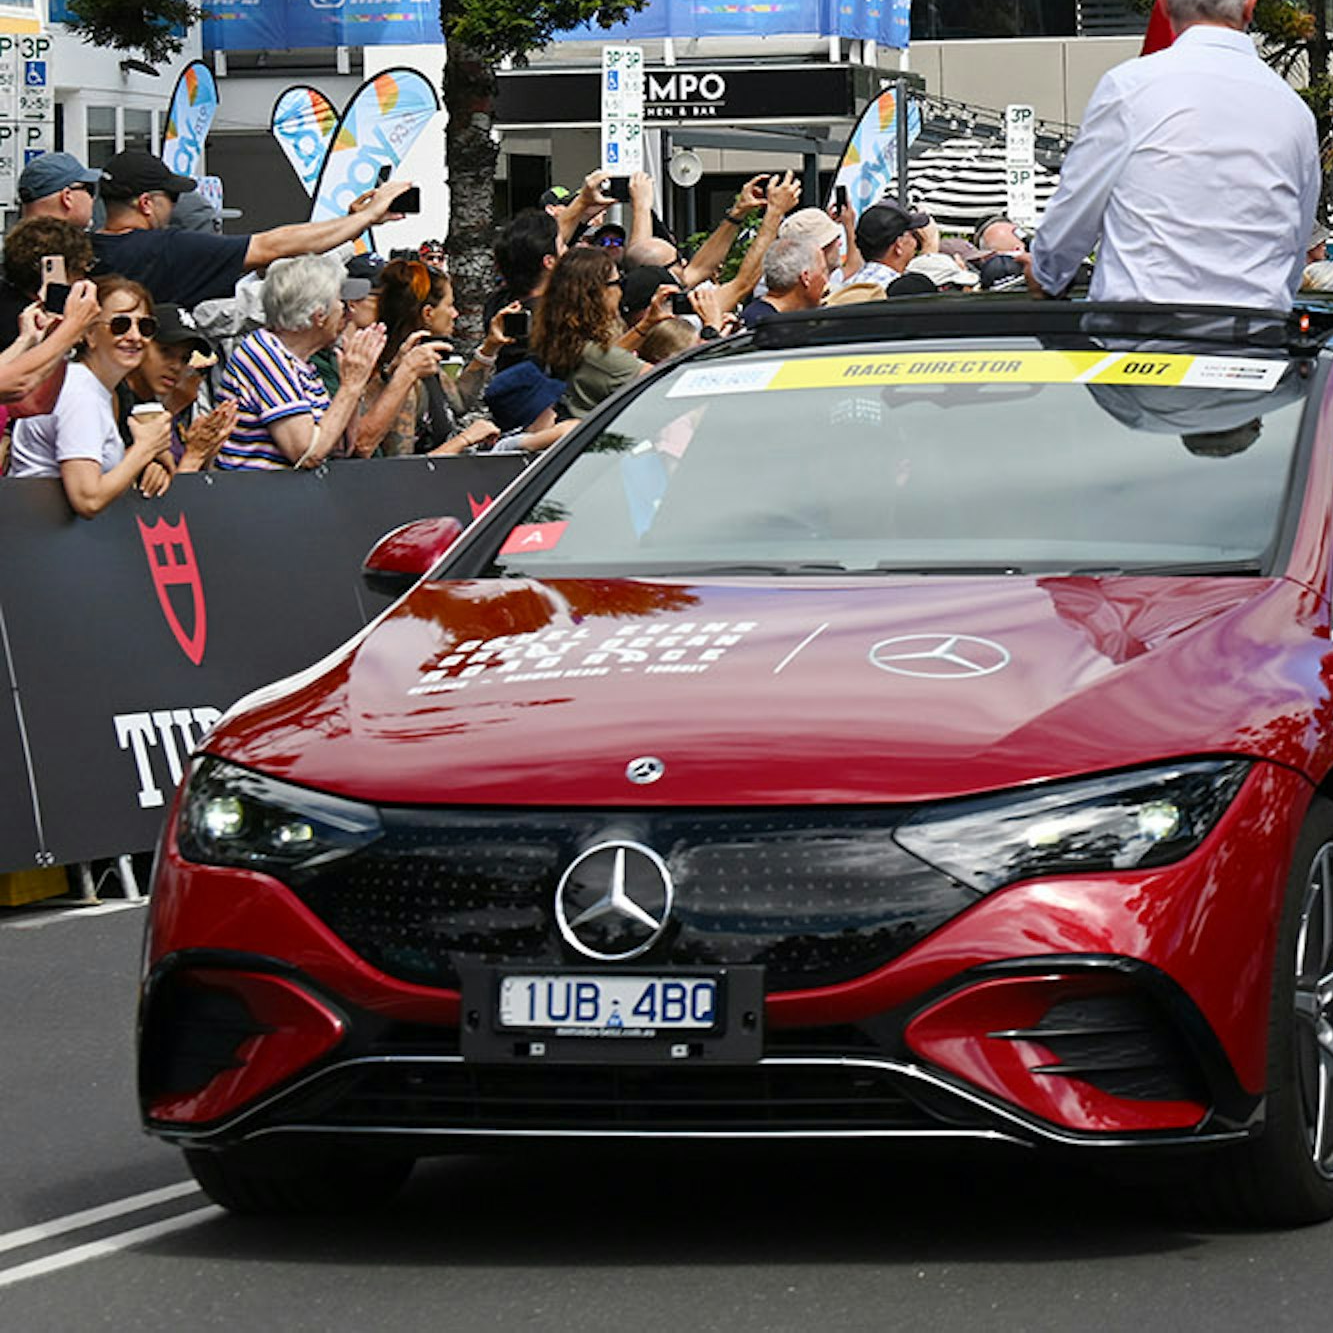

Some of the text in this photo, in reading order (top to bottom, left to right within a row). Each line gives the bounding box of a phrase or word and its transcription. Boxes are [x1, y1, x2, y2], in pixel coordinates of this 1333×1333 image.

[21, 38, 51, 59] 3P
[1010, 108, 1033, 124] 3P
[1010, 170, 1031, 185] 3P
[843, 360, 1023, 377] RACE DIRECTOR
[1122, 361, 1171, 375] 007
[526, 982, 600, 1022] 1UB
